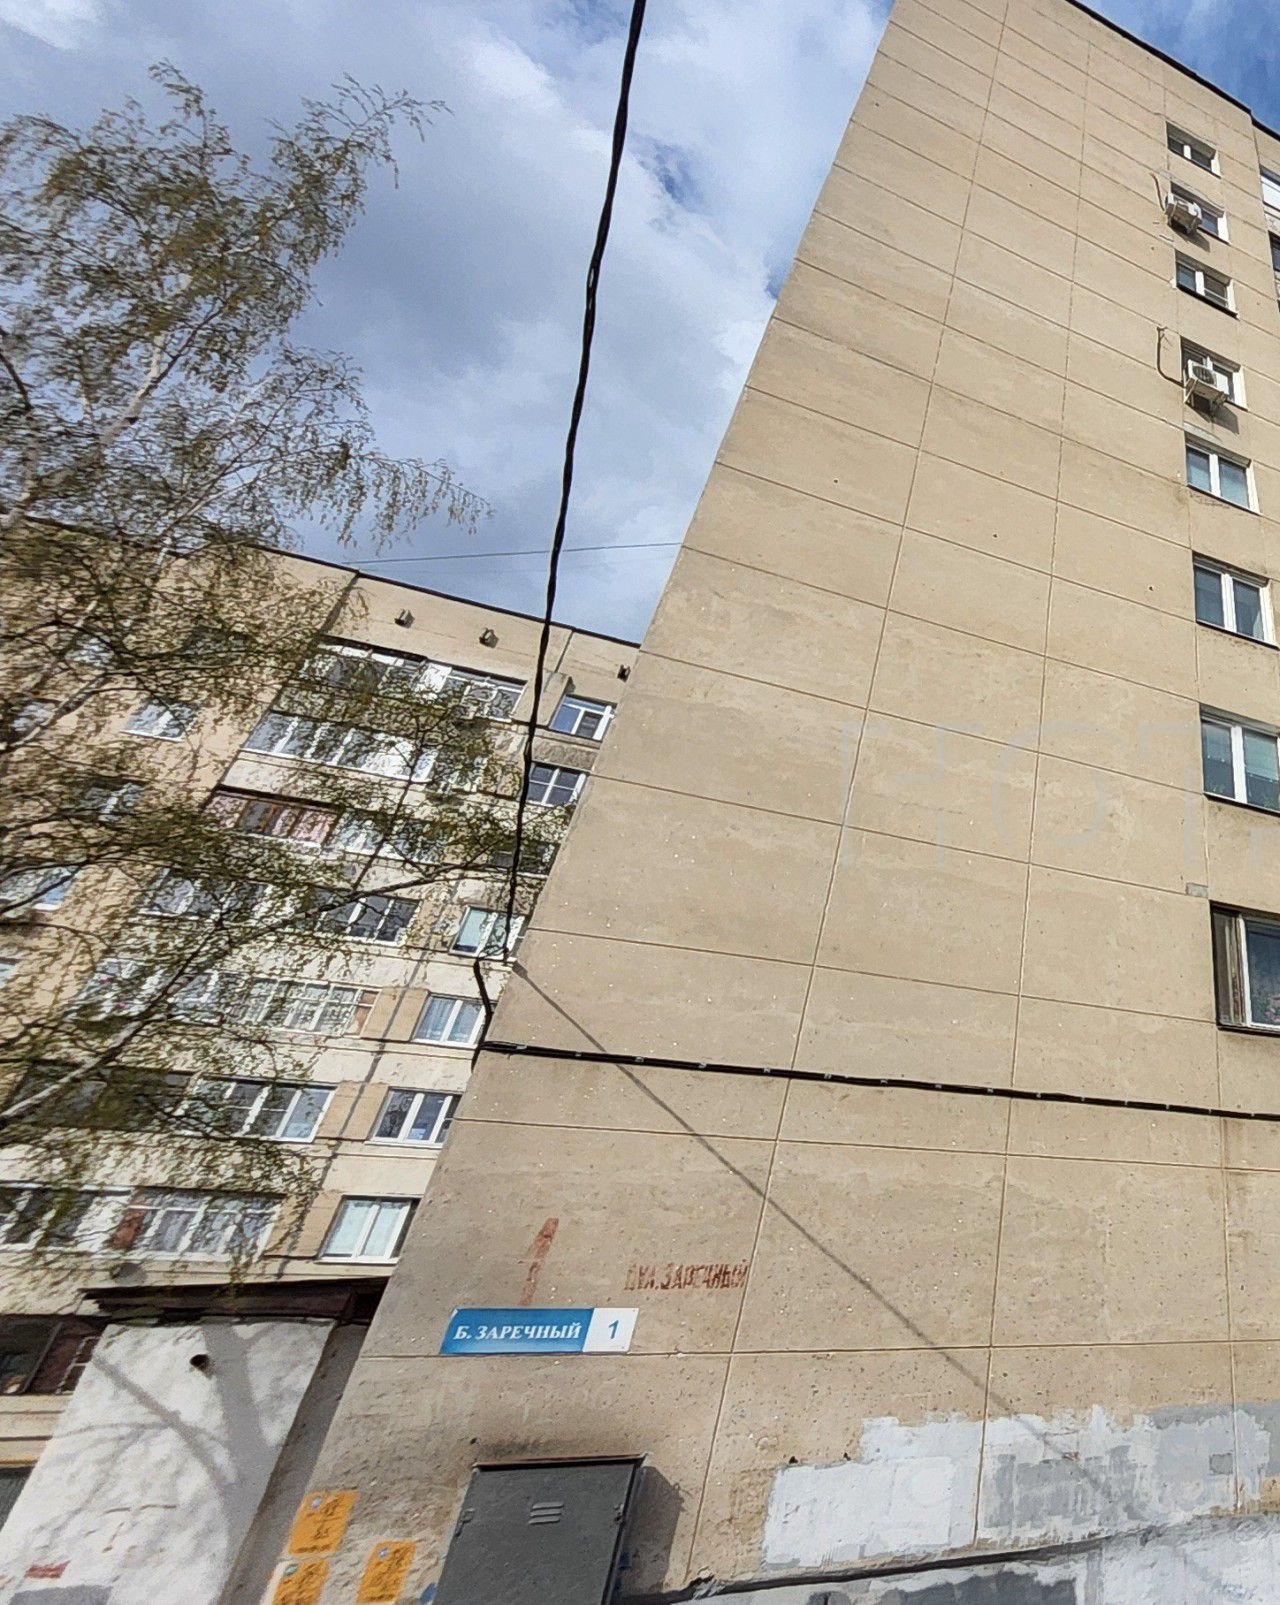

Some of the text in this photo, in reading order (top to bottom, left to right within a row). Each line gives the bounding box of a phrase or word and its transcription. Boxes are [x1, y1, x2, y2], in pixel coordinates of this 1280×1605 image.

[453, 1319, 620, 1340] Б. ЗАРЕЧНЫЙ 1
